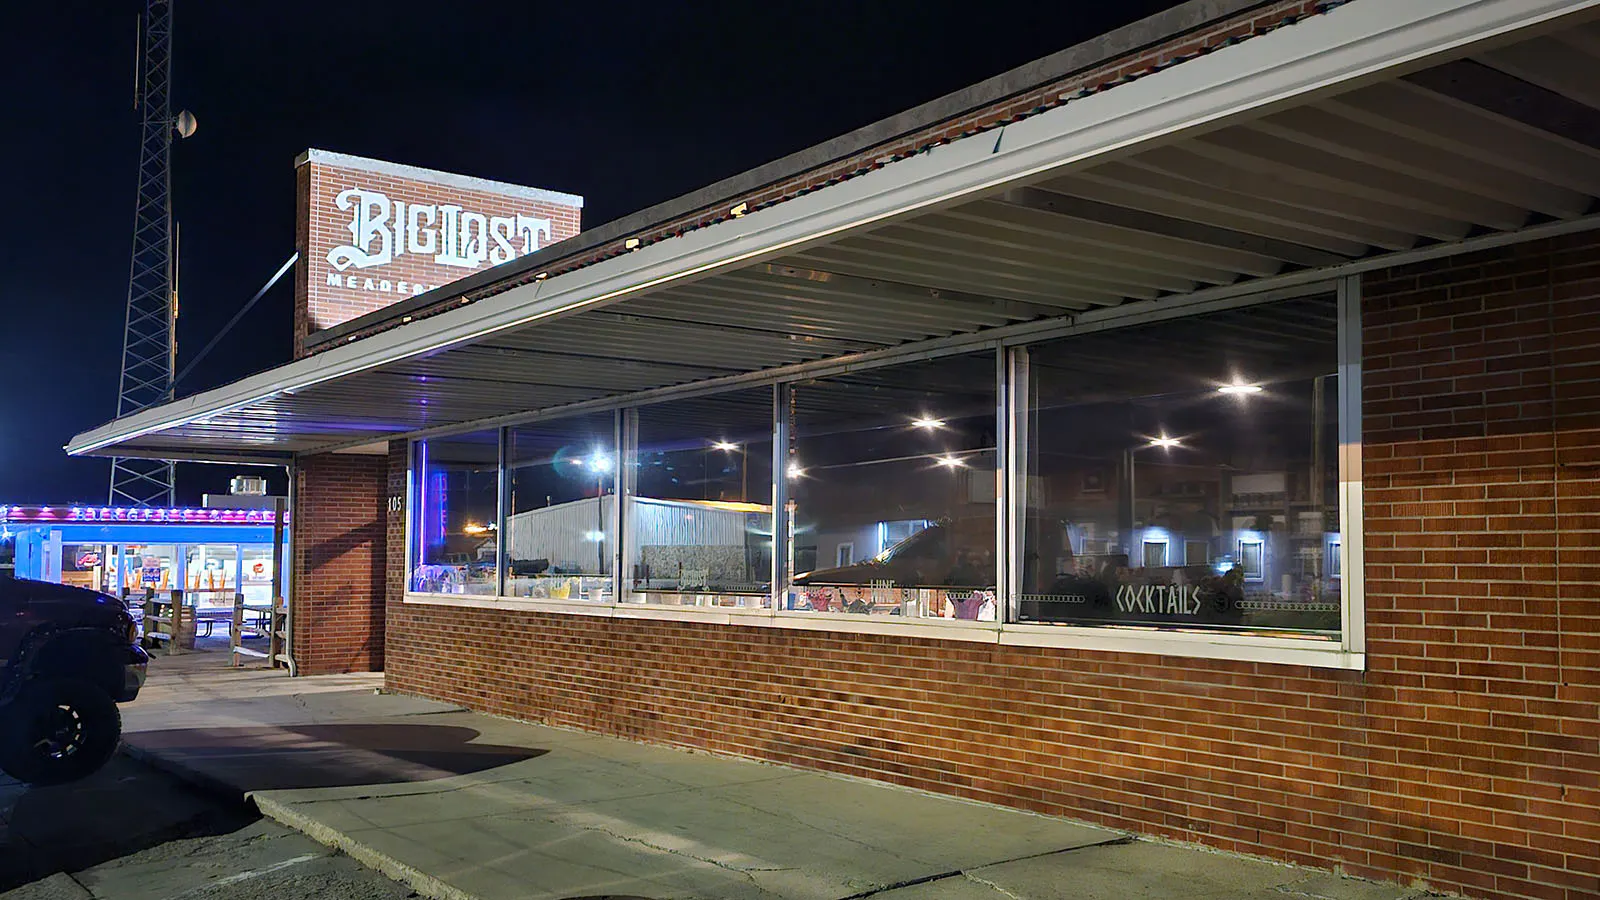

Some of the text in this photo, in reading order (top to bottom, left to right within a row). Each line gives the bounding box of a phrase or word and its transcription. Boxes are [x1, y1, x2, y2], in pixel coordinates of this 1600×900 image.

[387, 496, 402, 512] 105
[76, 508, 188, 522] BURGERS
[1116, 584, 1201, 615] COCKTAILS
